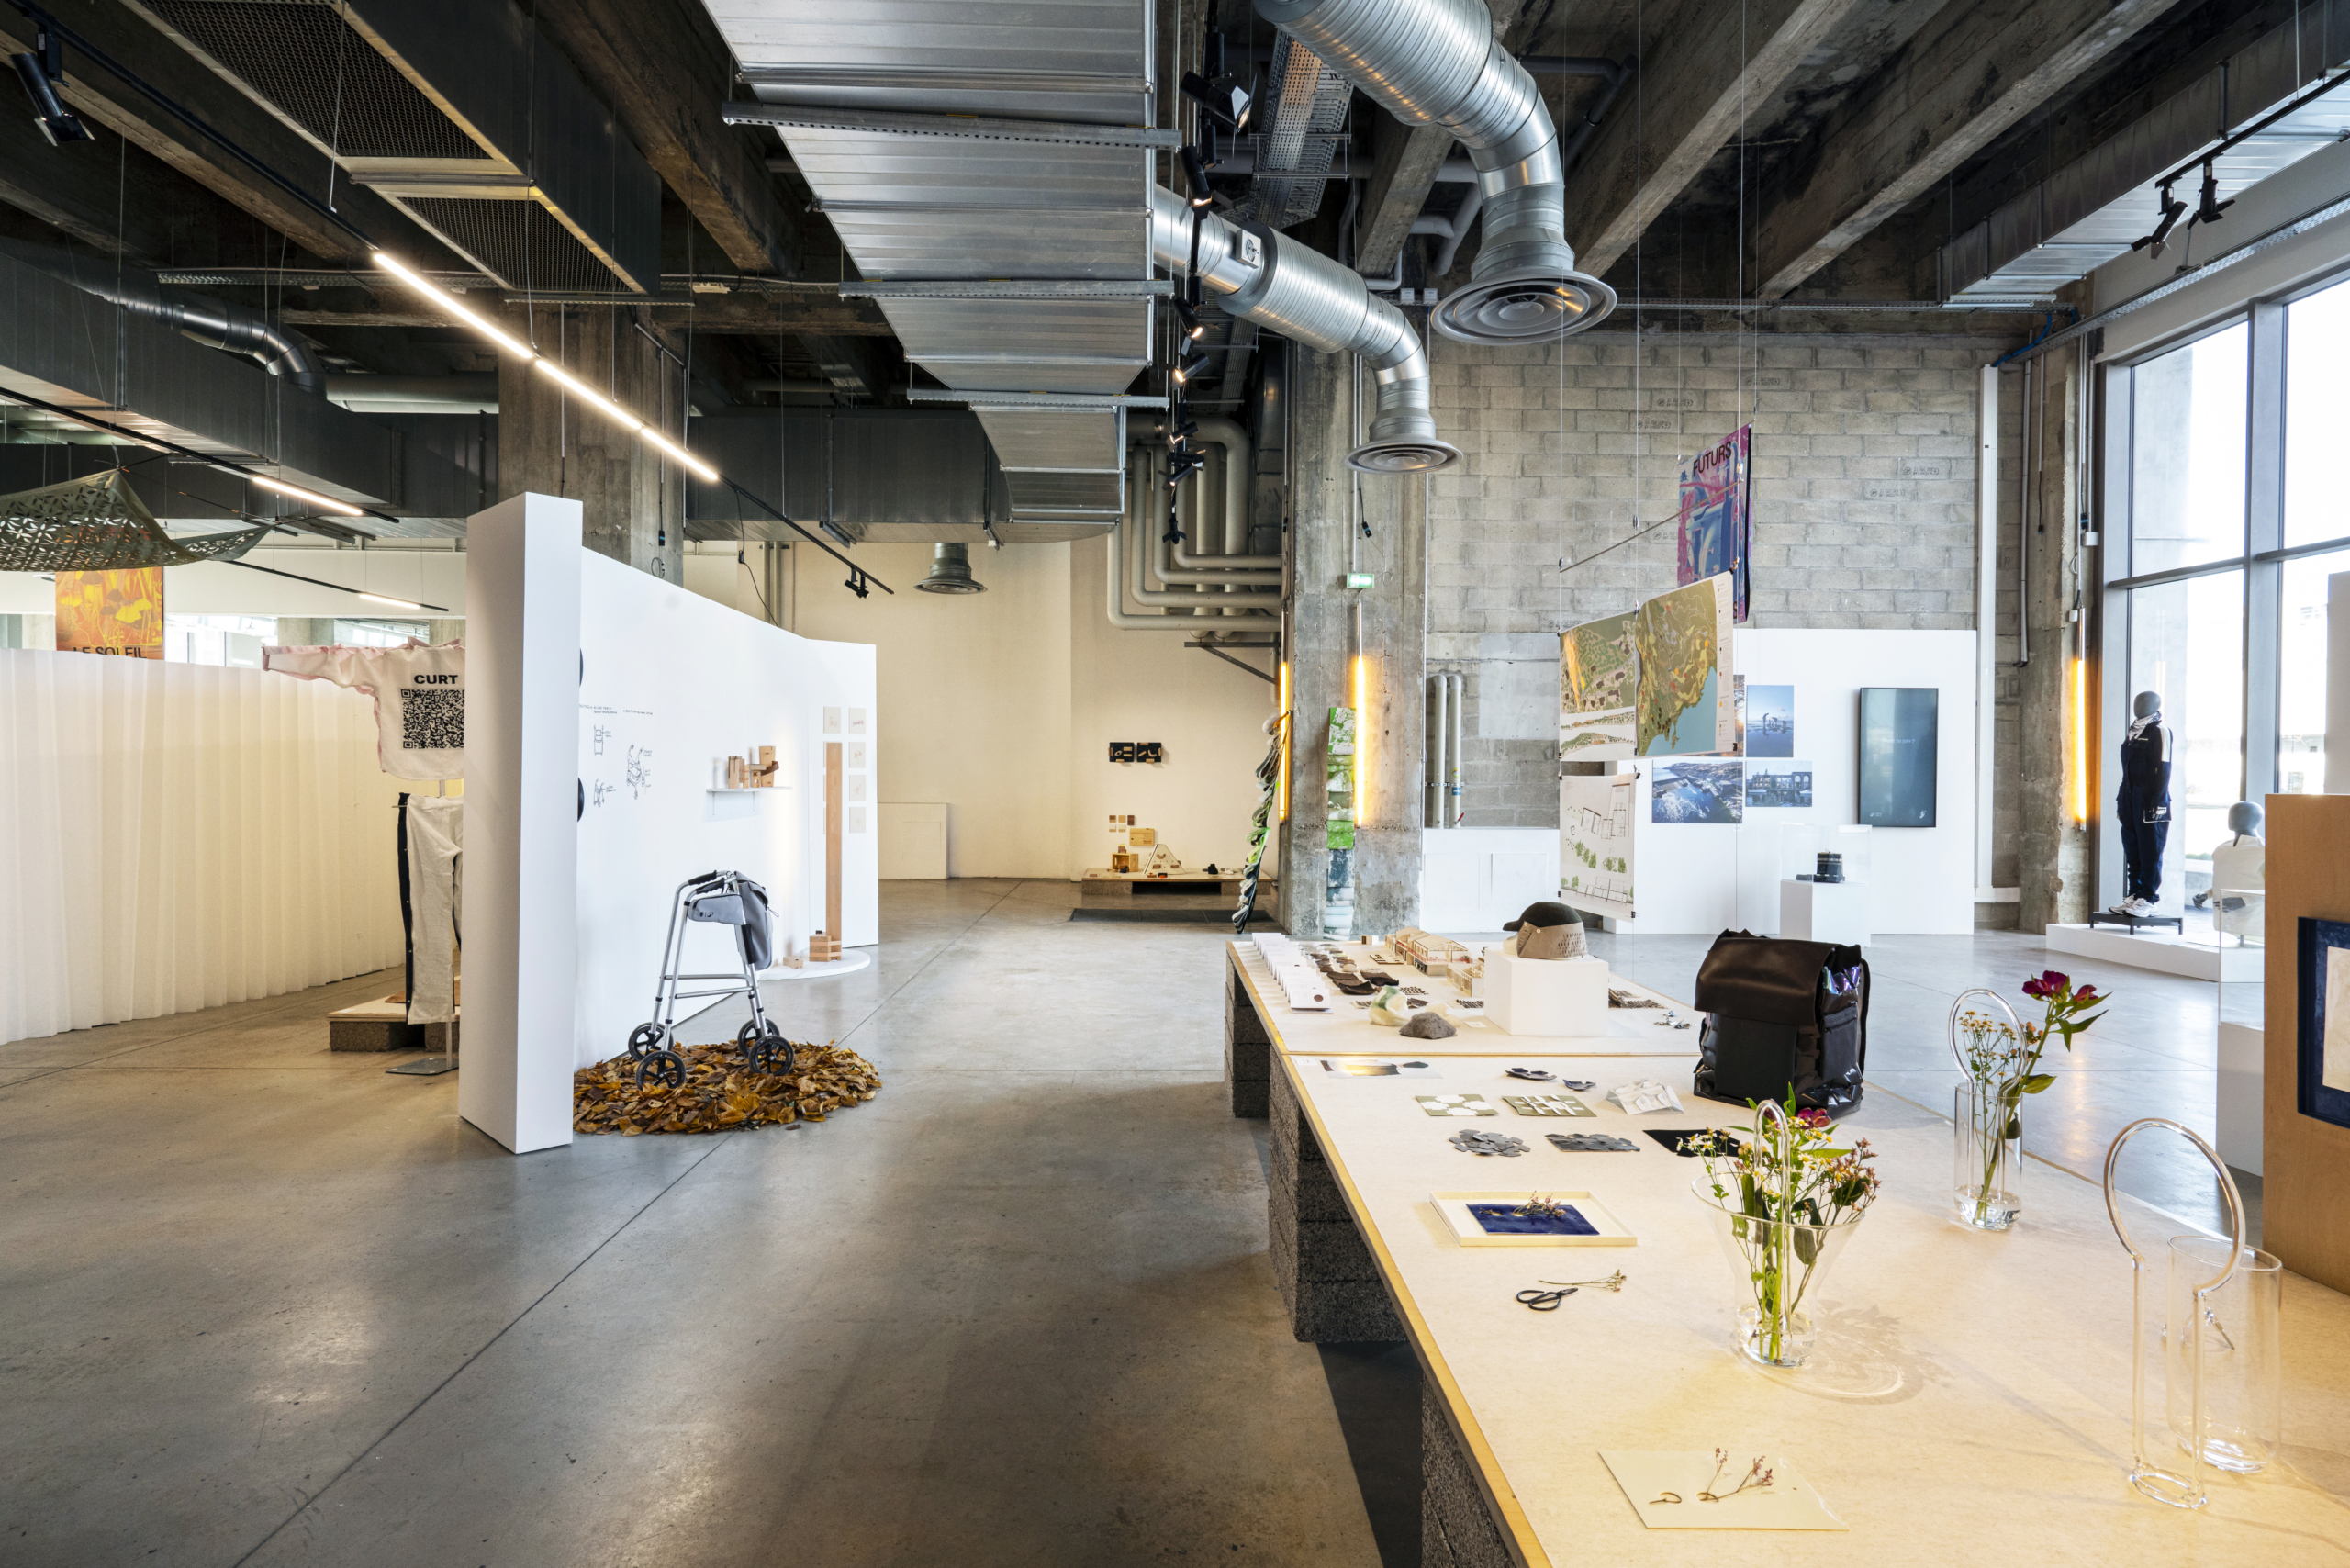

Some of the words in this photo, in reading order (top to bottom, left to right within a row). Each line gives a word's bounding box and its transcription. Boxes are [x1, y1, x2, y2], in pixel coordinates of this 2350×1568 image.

[1693, 441, 1732, 477] FUTURS
[95, 646, 147, 659] SOLEIL
[413, 674, 459, 685] CURT
